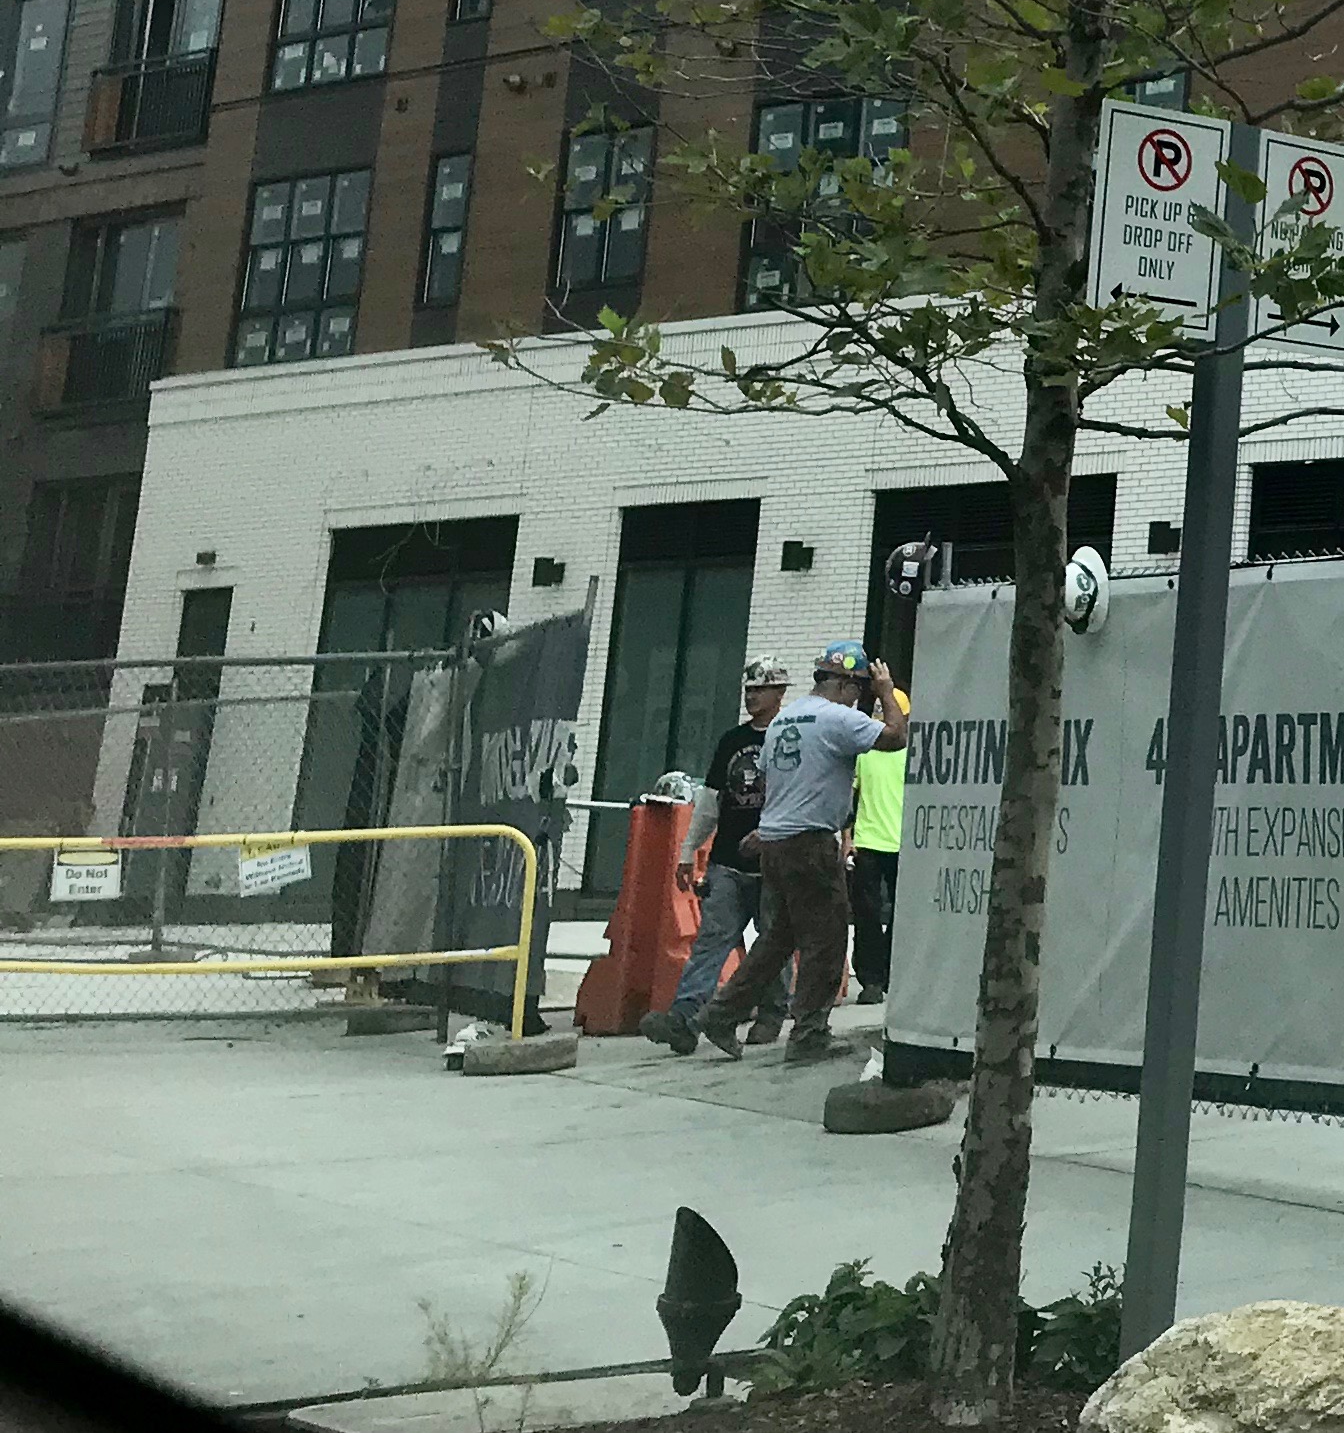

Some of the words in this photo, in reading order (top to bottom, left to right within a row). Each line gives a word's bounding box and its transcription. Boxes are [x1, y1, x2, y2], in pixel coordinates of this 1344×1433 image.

[1125, 195, 1158, 220] PICK
[1163, 201, 1182, 223] UP
[1123, 224, 1163, 248] DROP
[1168, 231, 1193, 254] OFF
[1138, 256, 1175, 280] ONLY
[904, 719, 1009, 785] EXCITIN
[1061, 718, 1094, 786] IX
[914, 804, 936, 849] OF
[65, 868, 82, 879] Do
[86, 868, 108, 878] Not
[68, 883, 102, 895] Enter
[1214, 875, 1341, 930] AMENITIES
